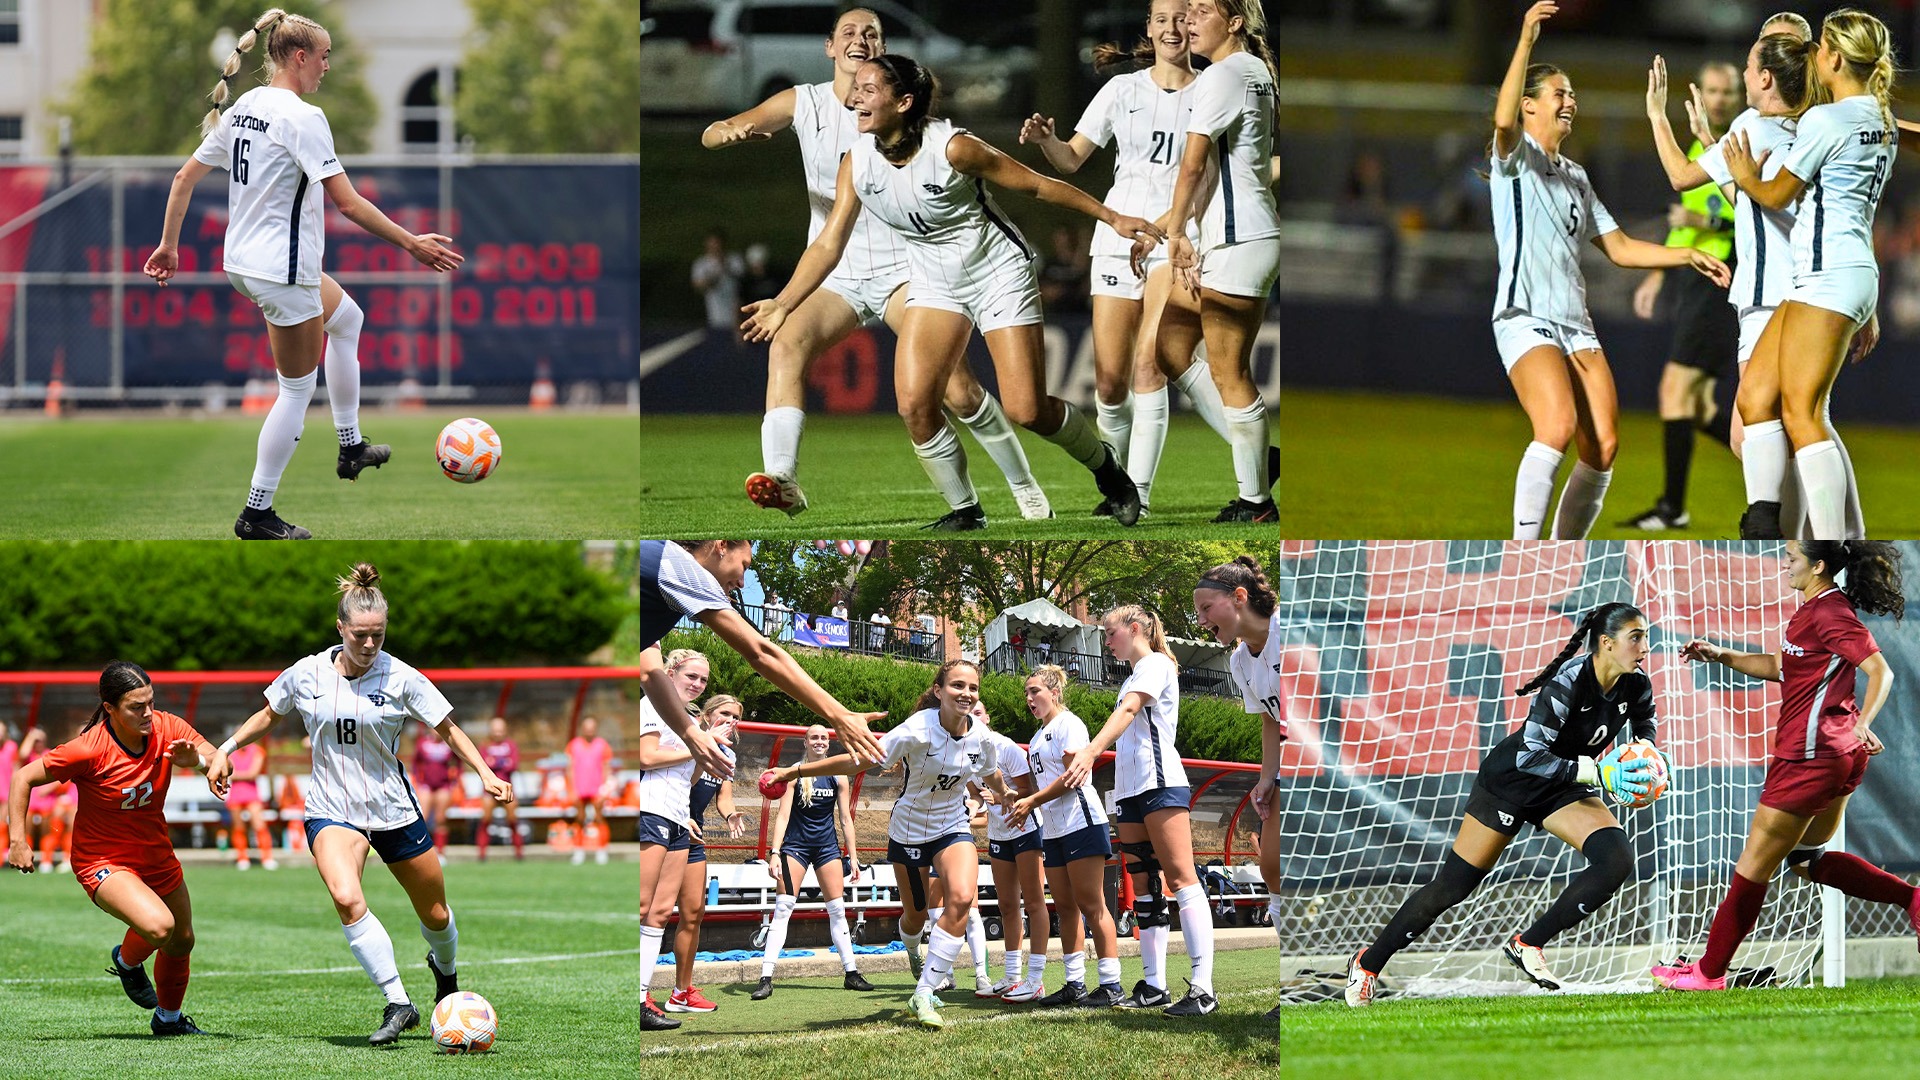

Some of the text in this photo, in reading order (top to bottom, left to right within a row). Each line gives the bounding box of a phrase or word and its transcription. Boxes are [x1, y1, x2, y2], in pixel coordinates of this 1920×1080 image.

[231, 114, 270, 134] AYTON
[232, 137, 251, 186] 16
[1150, 130, 1174, 166] 21
[907, 211, 935, 237] 11
[1565, 203, 1578, 237] 5
[473, 242, 602, 282] 2003
[494, 287, 595, 327] 2011
[336, 718, 357, 745] 18
[120, 781, 154, 810] 22
[812, 788, 834, 797] YTON
[930, 774, 961, 793] 30
